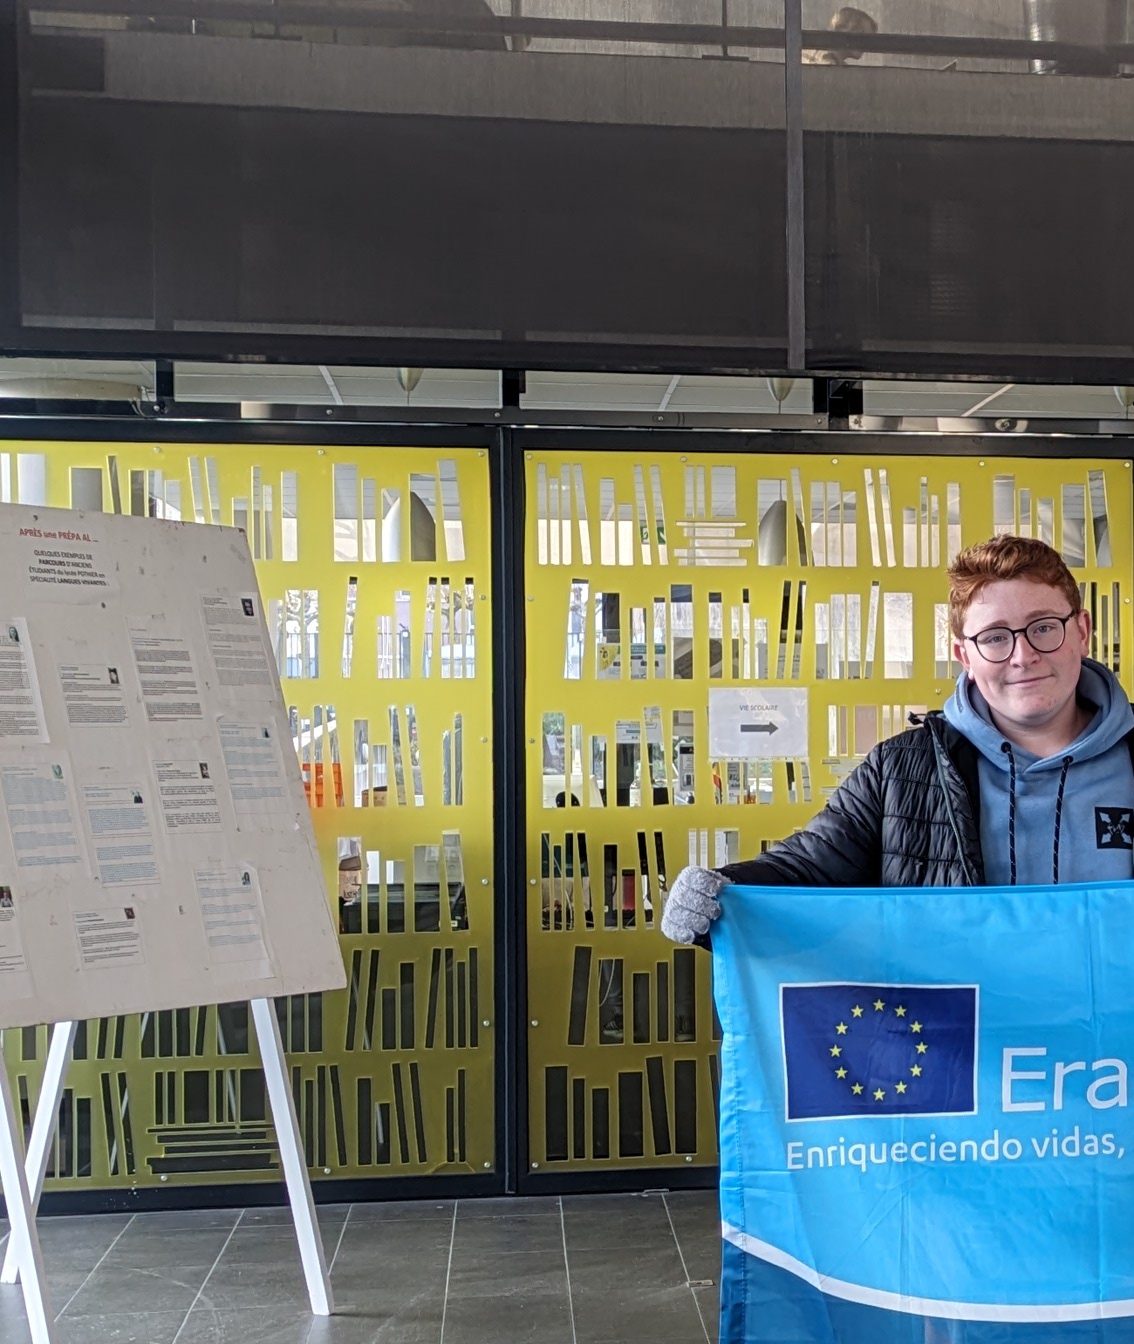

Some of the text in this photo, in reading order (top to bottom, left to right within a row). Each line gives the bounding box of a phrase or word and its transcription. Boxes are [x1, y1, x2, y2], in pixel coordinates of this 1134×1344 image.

[19, 527, 42, 538] APRÈS
[58, 530, 81, 541] PRÉPA
[786, 1128, 1022, 1173] Enriqueciendo
[1030, 1124, 1126, 1160] vidas,
